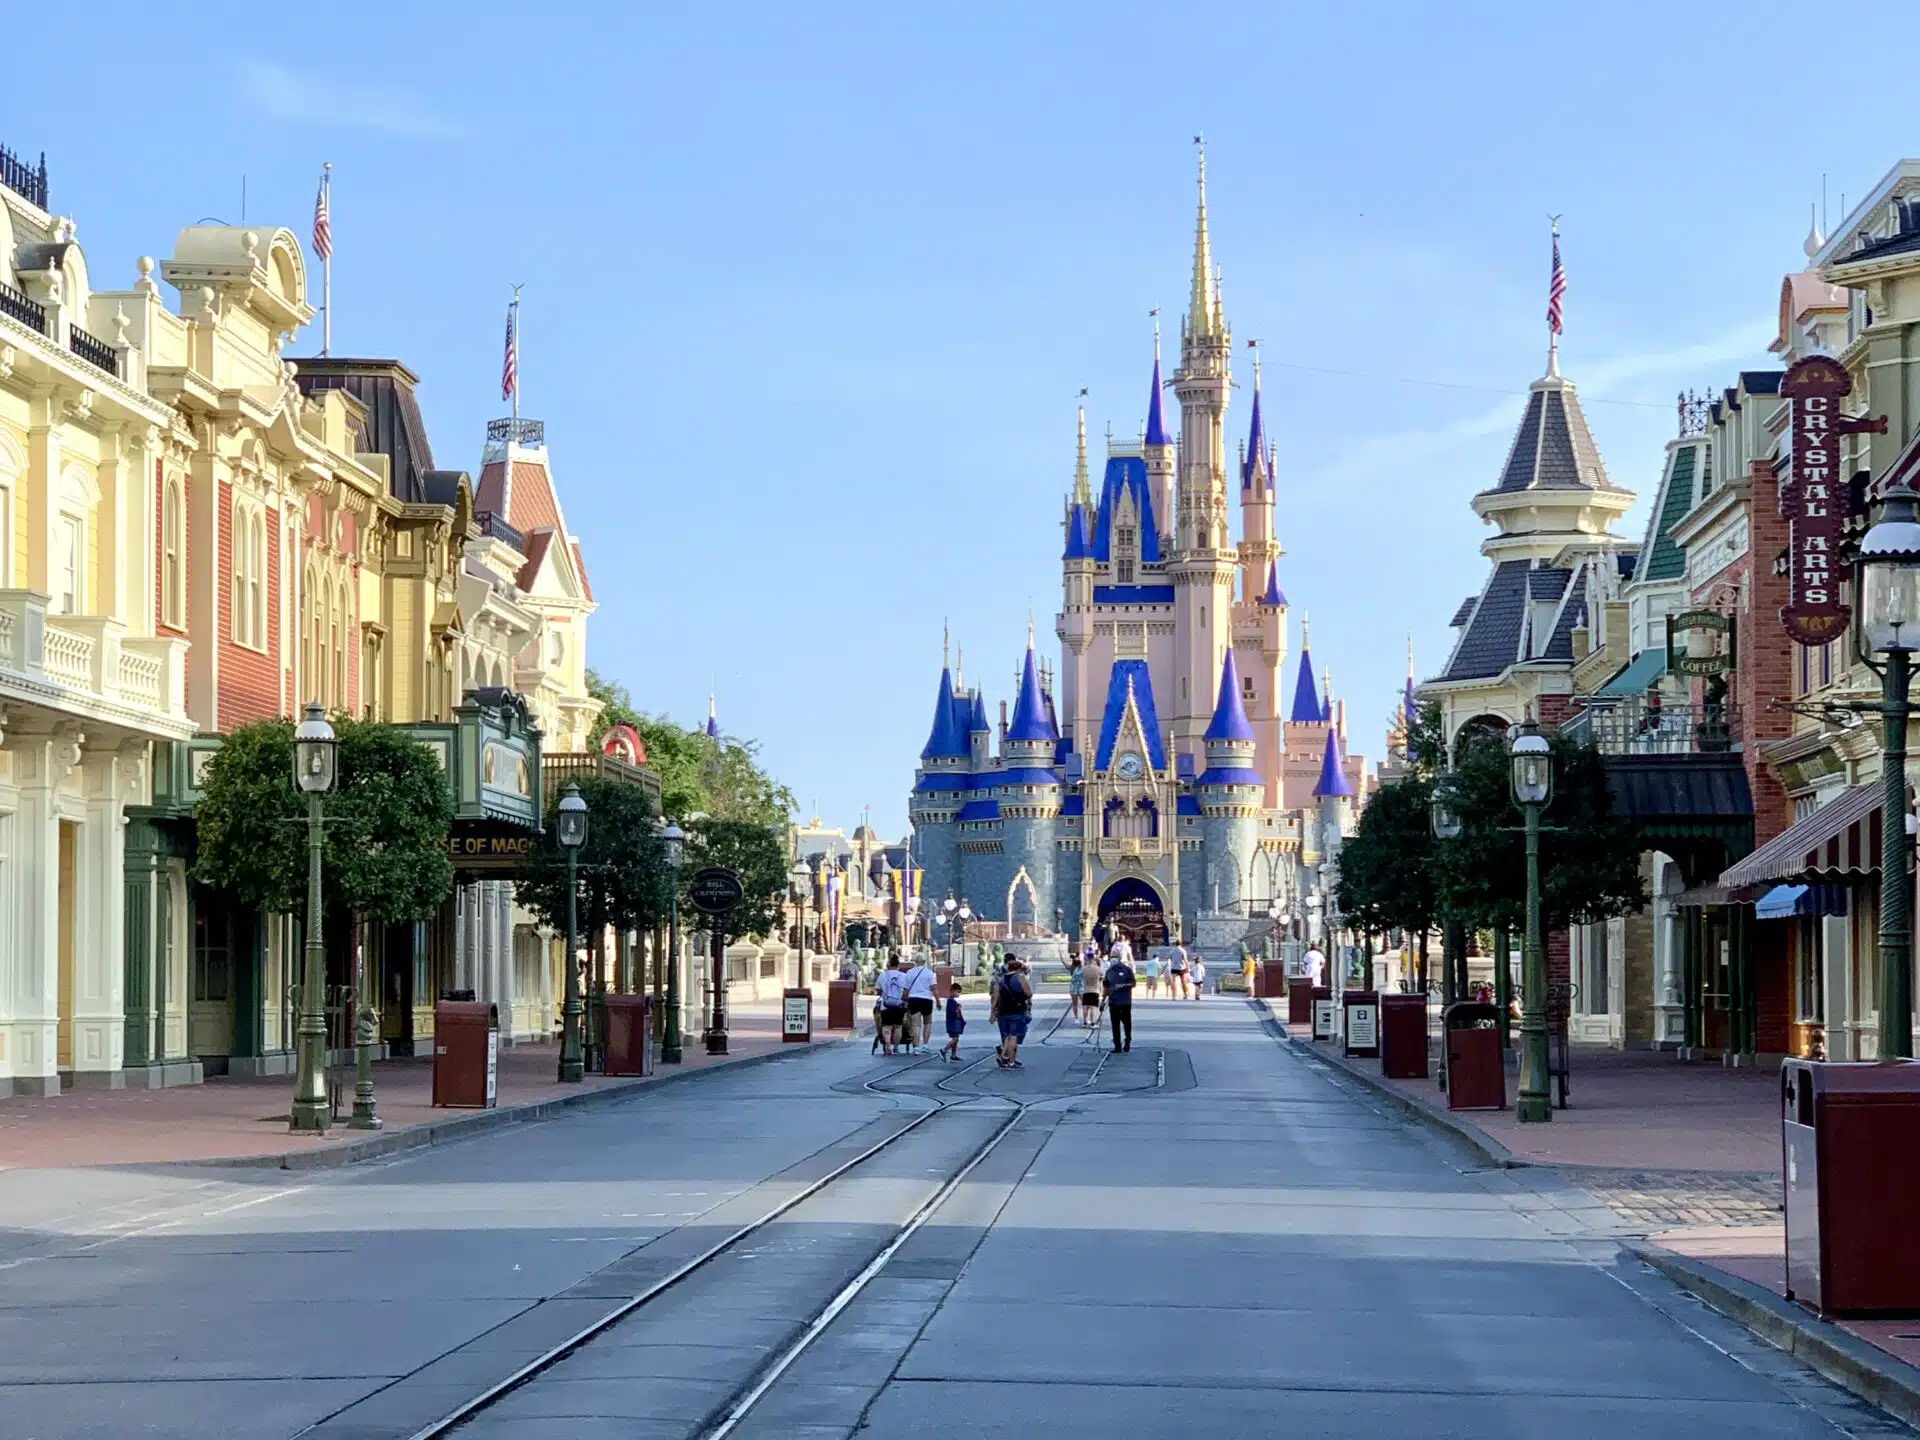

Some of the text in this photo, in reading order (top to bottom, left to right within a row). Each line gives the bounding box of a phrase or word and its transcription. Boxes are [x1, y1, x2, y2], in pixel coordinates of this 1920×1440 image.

[1803, 397, 1829, 604] CRYSTAL ARTS
[465, 838, 487, 854] OF
